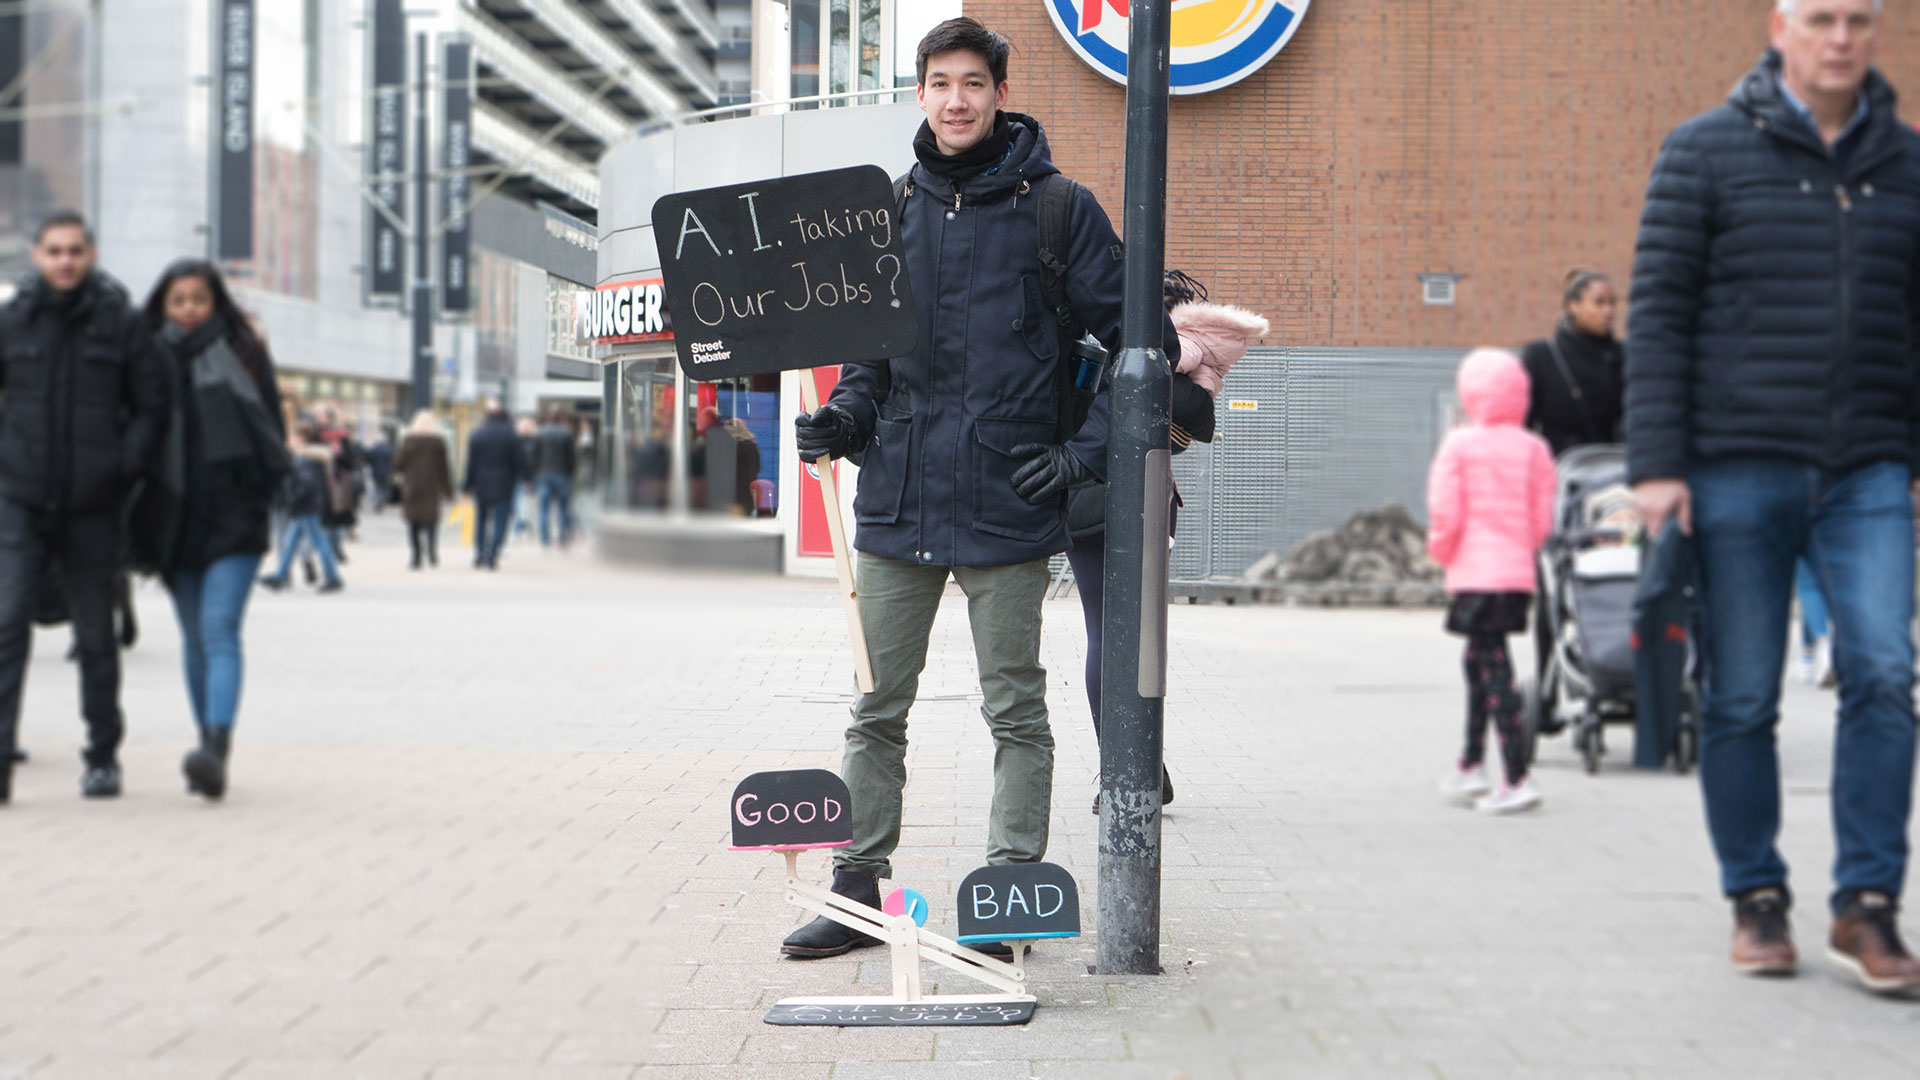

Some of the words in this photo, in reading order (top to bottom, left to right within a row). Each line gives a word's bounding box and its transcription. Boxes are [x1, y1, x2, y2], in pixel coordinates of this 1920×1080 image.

[790, 208, 892, 248] taking
[580, 284, 664, 339] BURGER
[692, 282, 776, 327] Our
[690, 340, 724, 354] Street
[693, 350, 732, 365] Debater
[735, 793, 842, 827] GOOD
[972, 883, 1064, 919] BAD
[794, 1012, 882, 1021] Our
